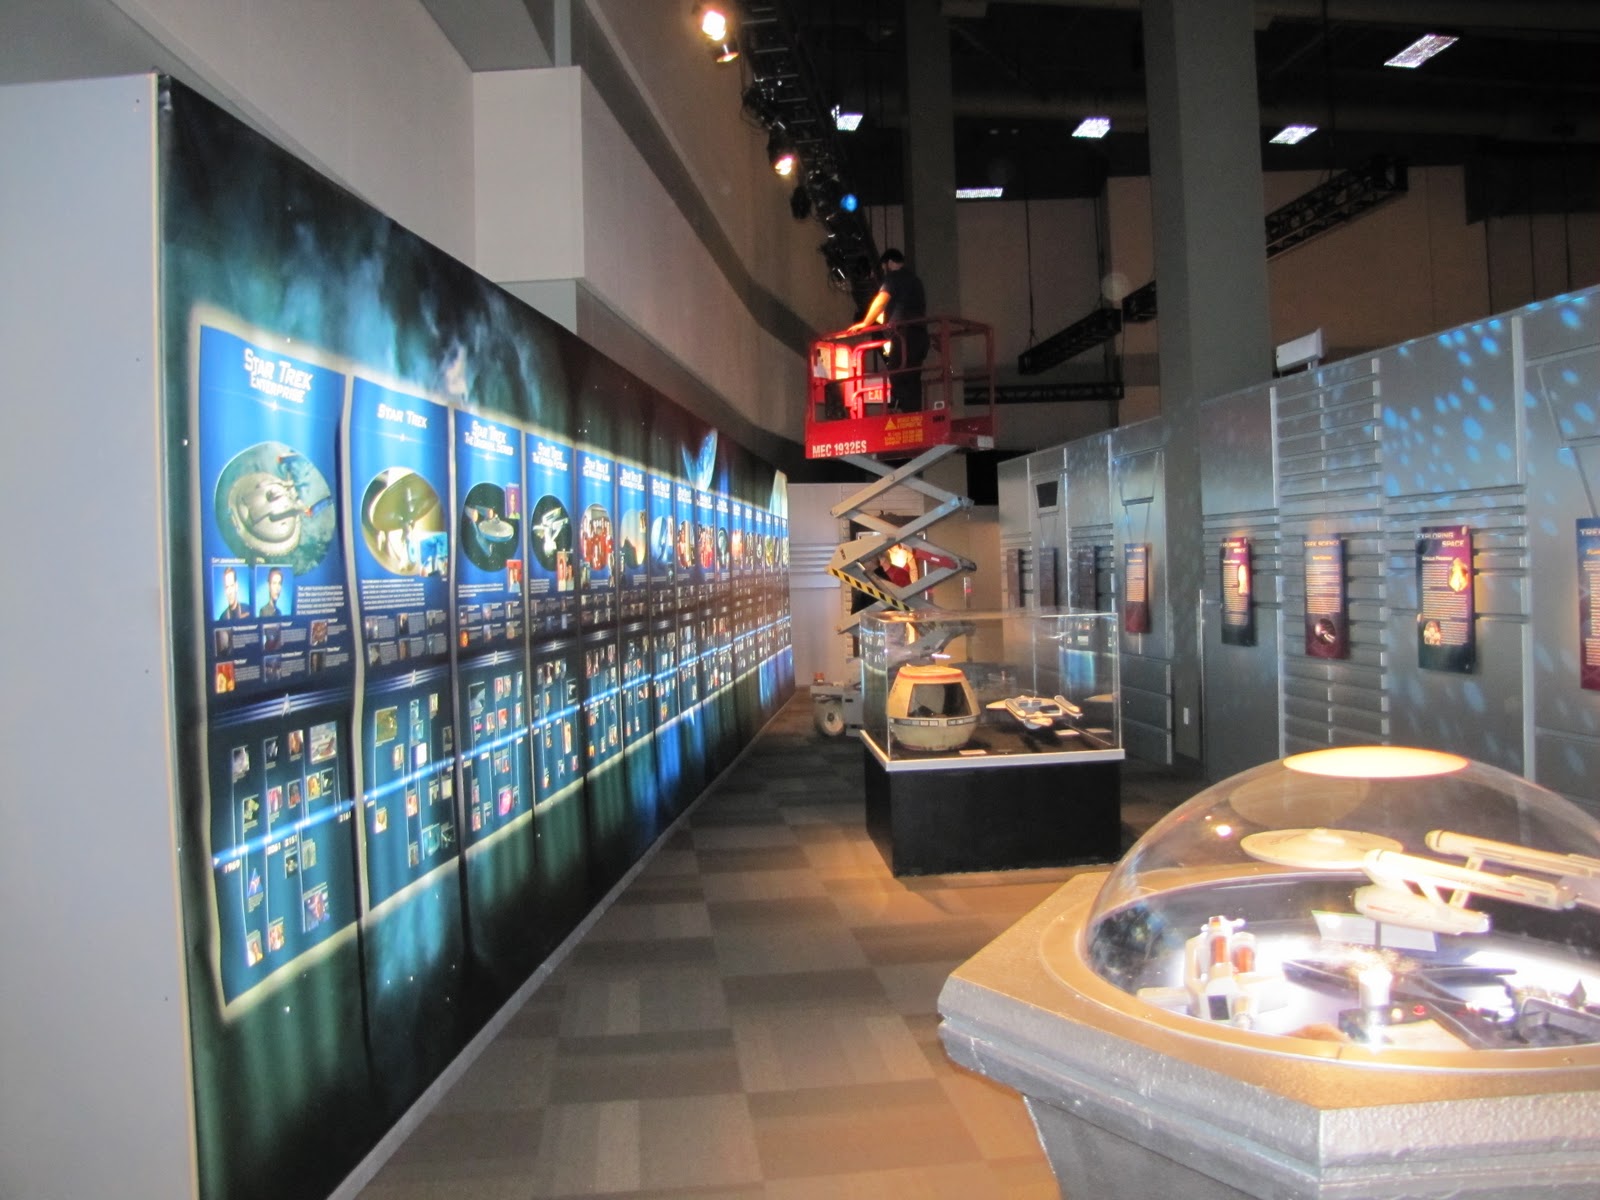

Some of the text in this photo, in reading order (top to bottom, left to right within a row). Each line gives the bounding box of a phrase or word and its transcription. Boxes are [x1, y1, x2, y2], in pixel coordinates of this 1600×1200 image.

[244, 347, 314, 392] STAR TREK
[377, 402, 428, 430] STAR TREK
[812, 440, 867, 458] MEC 1932ES
[1416, 531, 1454, 539] EXPLORING
[1579, 528, 1600, 537] TRE
[1441, 539, 1465, 548] SPACE
